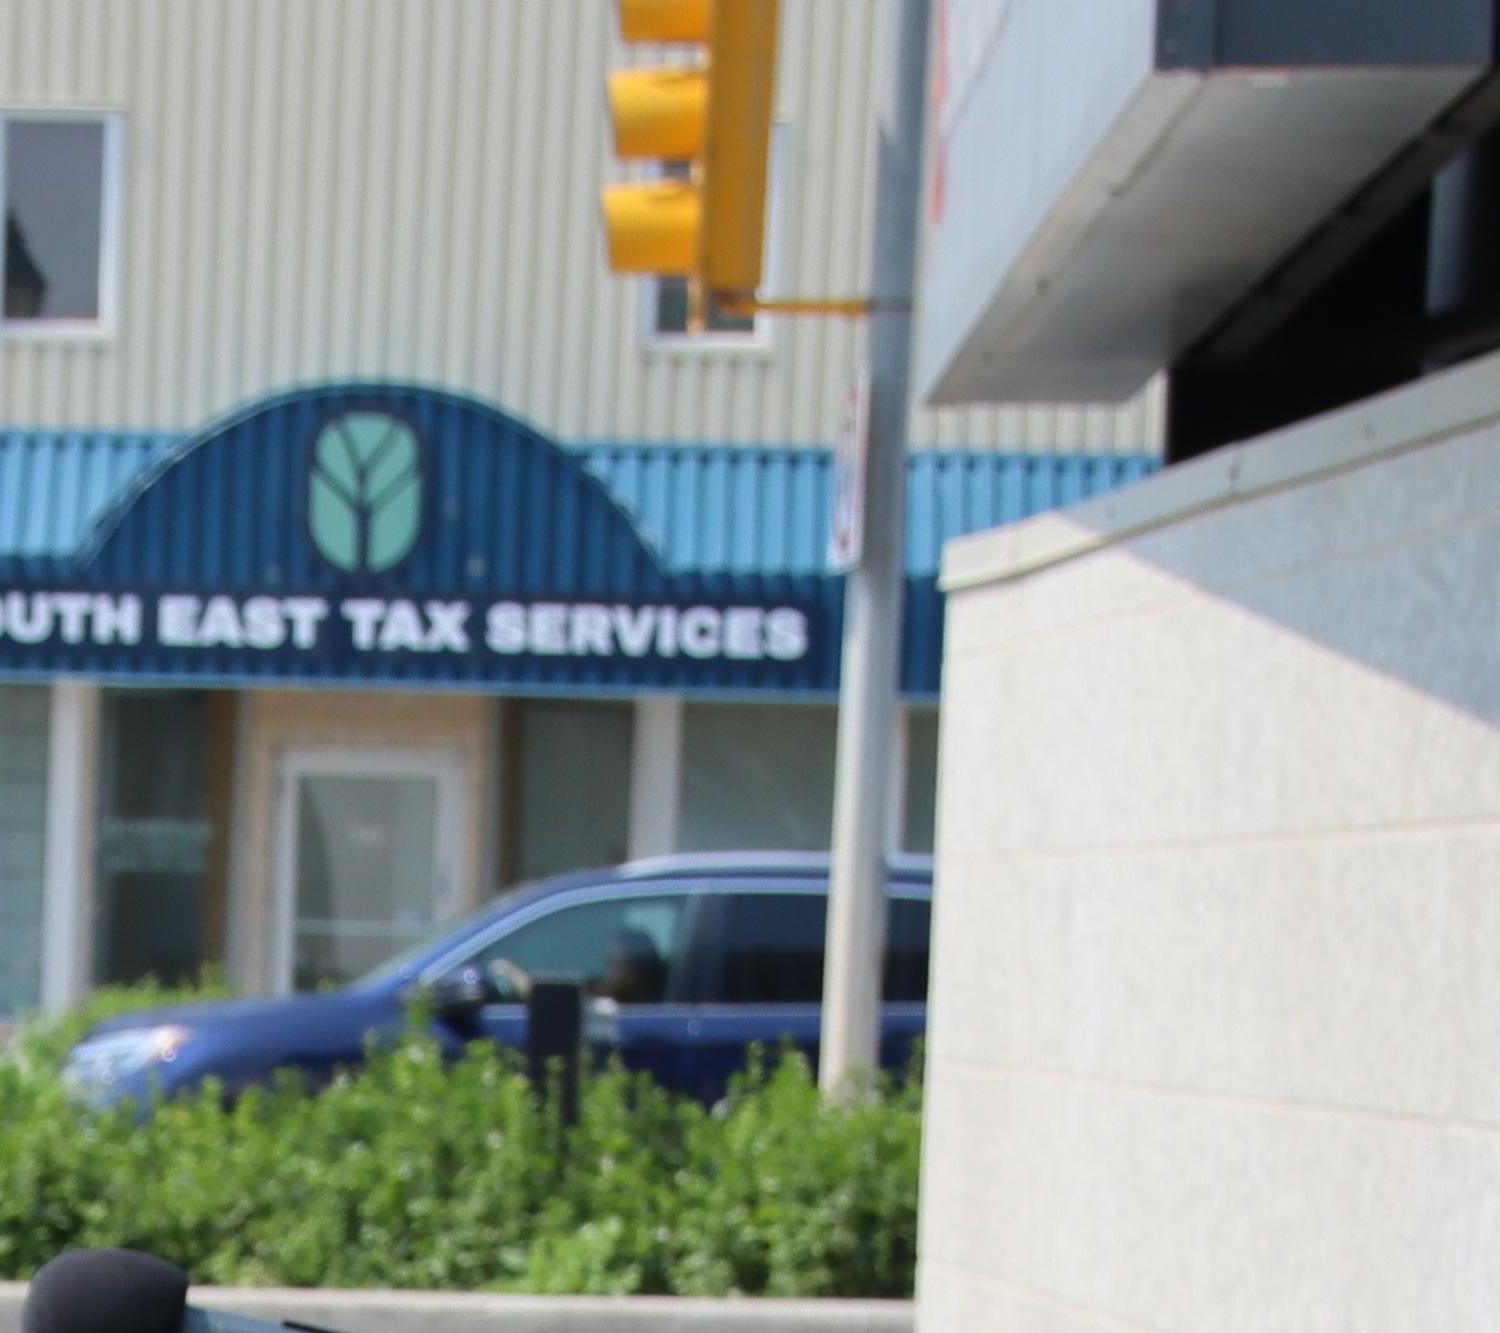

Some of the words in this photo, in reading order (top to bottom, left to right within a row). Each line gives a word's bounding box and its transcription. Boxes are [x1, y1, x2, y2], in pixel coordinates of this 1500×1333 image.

[156, 594, 330, 650] EAST
[340, 598, 471, 654] TAX
[486, 601, 809, 660] SERVICES
